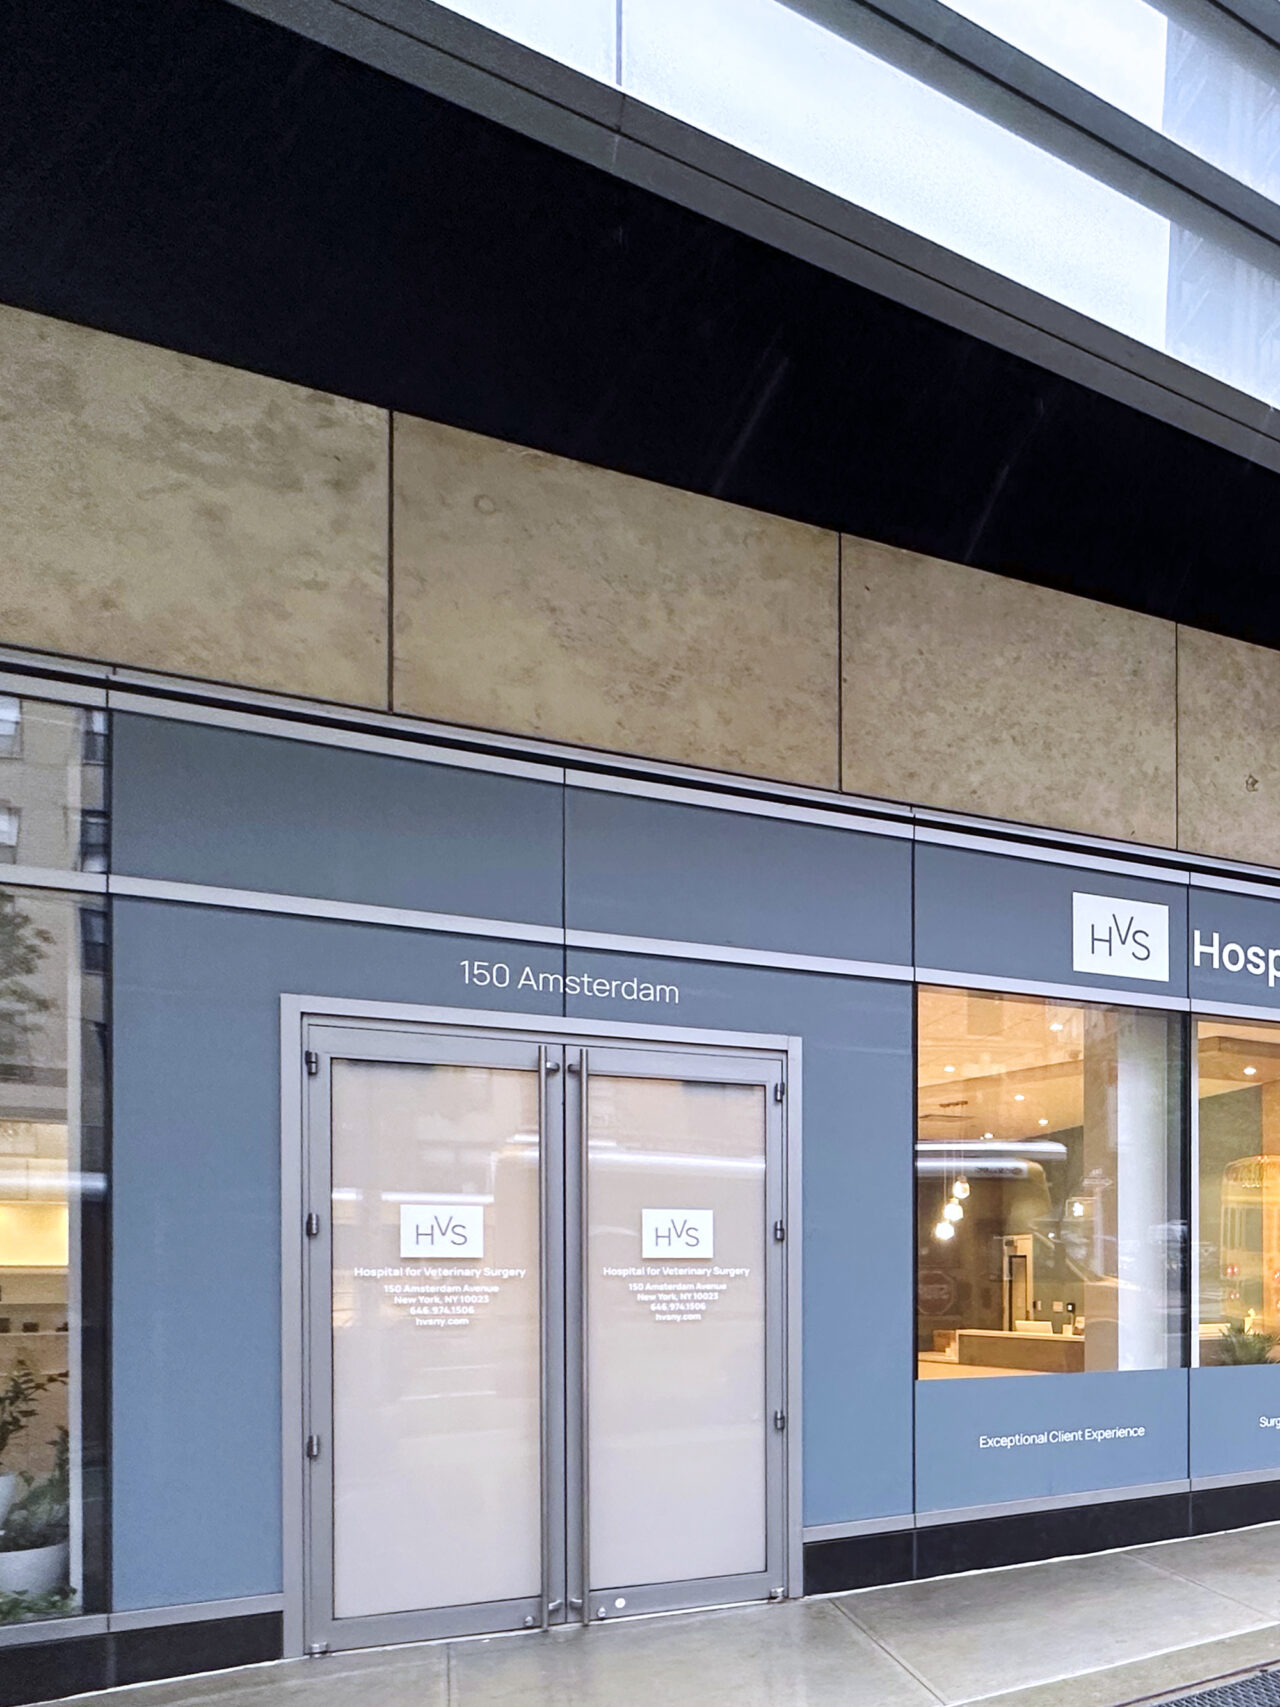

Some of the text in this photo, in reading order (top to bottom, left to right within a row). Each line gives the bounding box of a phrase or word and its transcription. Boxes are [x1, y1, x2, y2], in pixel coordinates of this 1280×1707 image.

[1091, 914, 1151, 961] HVS
[460, 960, 680, 1004] 150 Amsterdam
[416, 1215, 468, 1246] HVS
[655, 1219, 700, 1247] HVS
[354, 1267, 526, 1279] Hospital for Veterinary Surgery
[603, 1267, 750, 1277] Hospital for Veterinary Surgery
[384, 1285, 499, 1293] 150 Amsterdam Avenue
[628, 1283, 643, 1291] 150
[645, 1283, 695, 1291] Amsterdam
[394, 1295, 490, 1304] New York, NY 10023
[637, 1293, 657, 1301] New
[658, 1293, 678, 1301] York,
[693, 1292, 719, 1300] 10023
[416, 1317, 469, 1327] hvsny.com
[655, 1313, 701, 1322] hvsny.com
[979, 1426, 1145, 1449] Exceptional Client Experience
